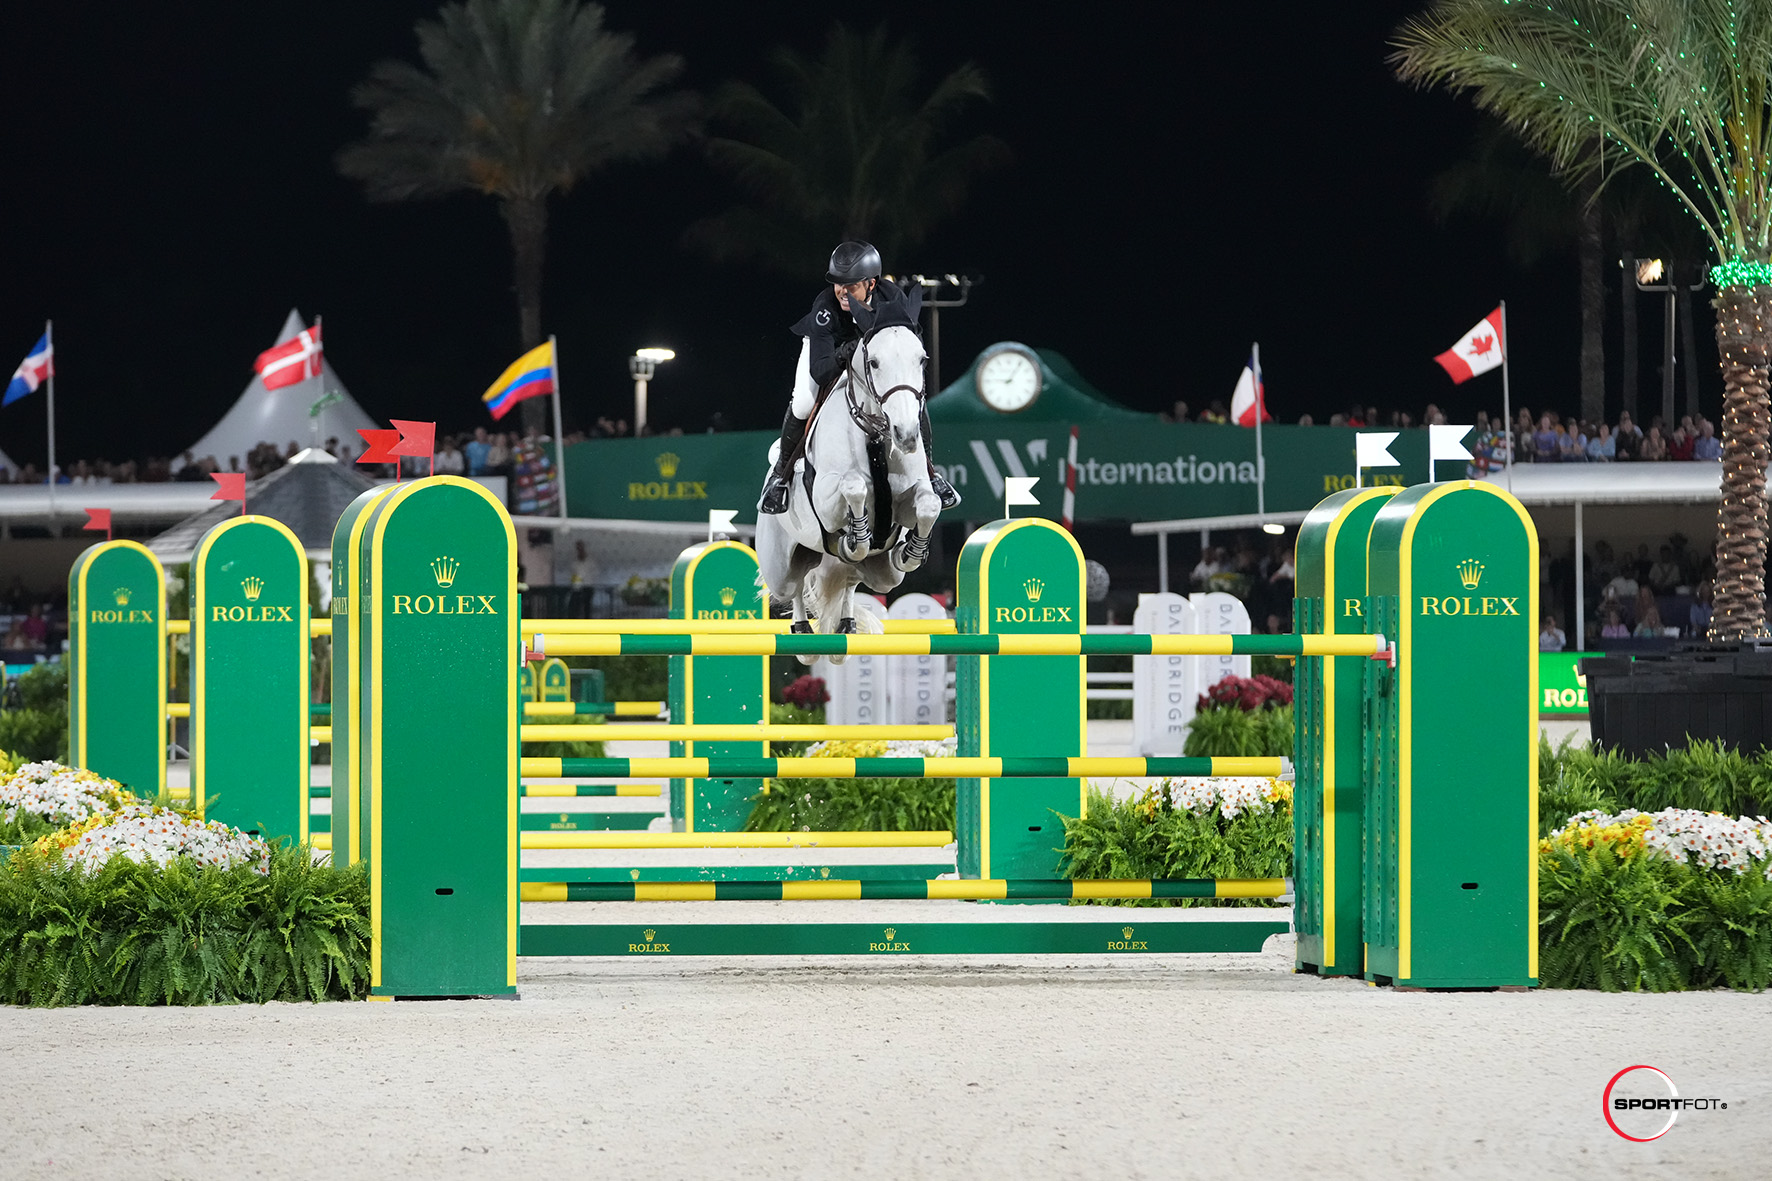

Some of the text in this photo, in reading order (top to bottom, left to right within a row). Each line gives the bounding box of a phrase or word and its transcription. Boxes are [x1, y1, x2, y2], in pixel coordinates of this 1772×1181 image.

[628, 481, 708, 500] ROLEX
[392, 594, 498, 615] ROLEX
[1420, 596, 1520, 616] ROLEX
[91, 610, 153, 623] ROLEX
[212, 606, 293, 622] ROLEX
[697, 609, 757, 620] ROLEX
[995, 607, 1072, 622] ROLEX
[1168, 604, 1182, 734] BAIBRIDGE
[1544, 688, 1589, 708] ROL
[628, 943, 670, 952] ROLEX
[869, 942, 910, 951] ROLEX
[1107, 941, 1148, 950] ROLEX
